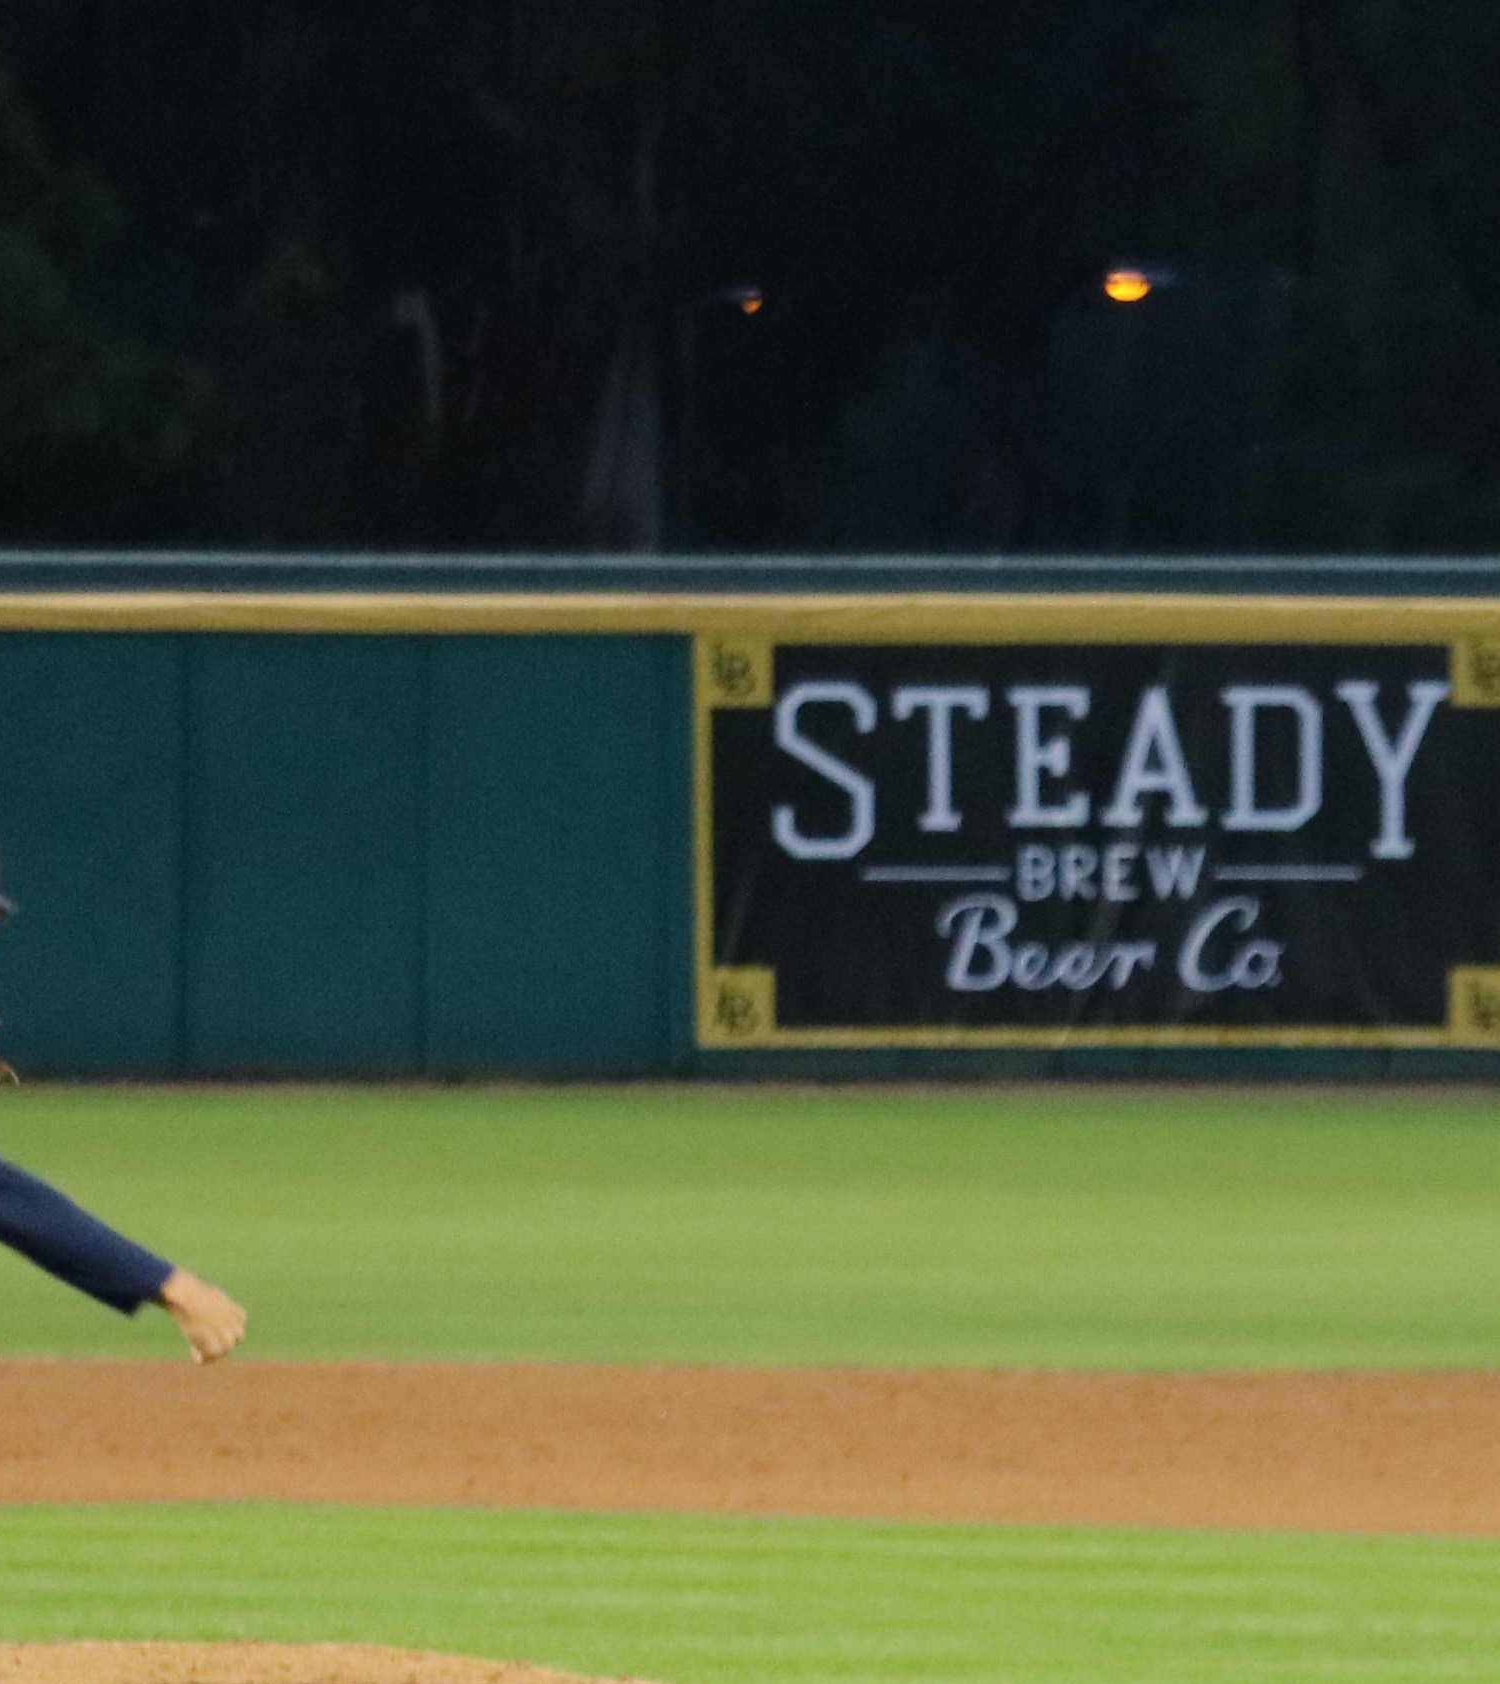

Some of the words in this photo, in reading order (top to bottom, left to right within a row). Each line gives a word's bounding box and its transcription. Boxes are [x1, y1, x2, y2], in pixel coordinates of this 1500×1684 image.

[770, 681, 1451, 860] STEADY
[1016, 843, 1206, 902] BREW
[936, 892, 1156, 992] Beer
